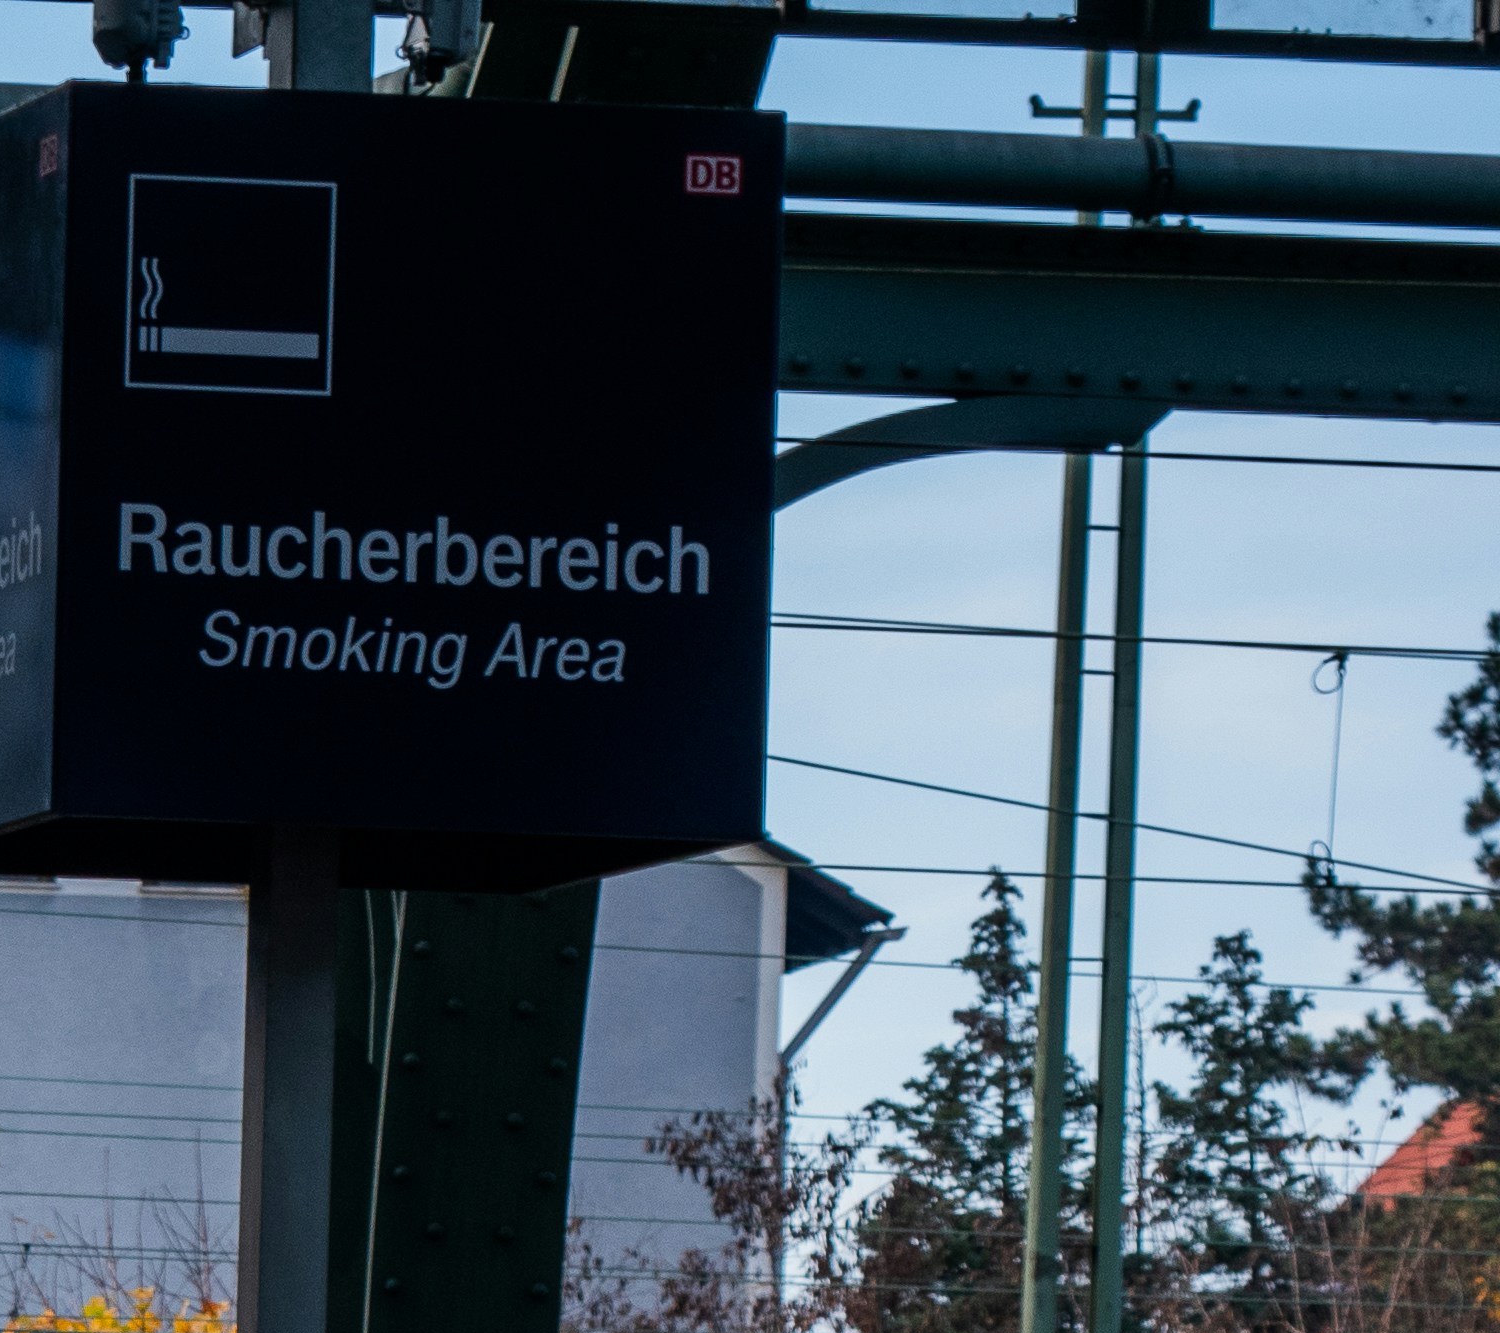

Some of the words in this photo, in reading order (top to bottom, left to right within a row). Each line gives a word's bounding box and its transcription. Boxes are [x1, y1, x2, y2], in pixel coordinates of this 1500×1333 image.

[689, 157, 738, 192] DB
[119, 503, 709, 594] Raucherbereich
[199, 610, 467, 689] Smoking
[485, 623, 625, 682] Area
